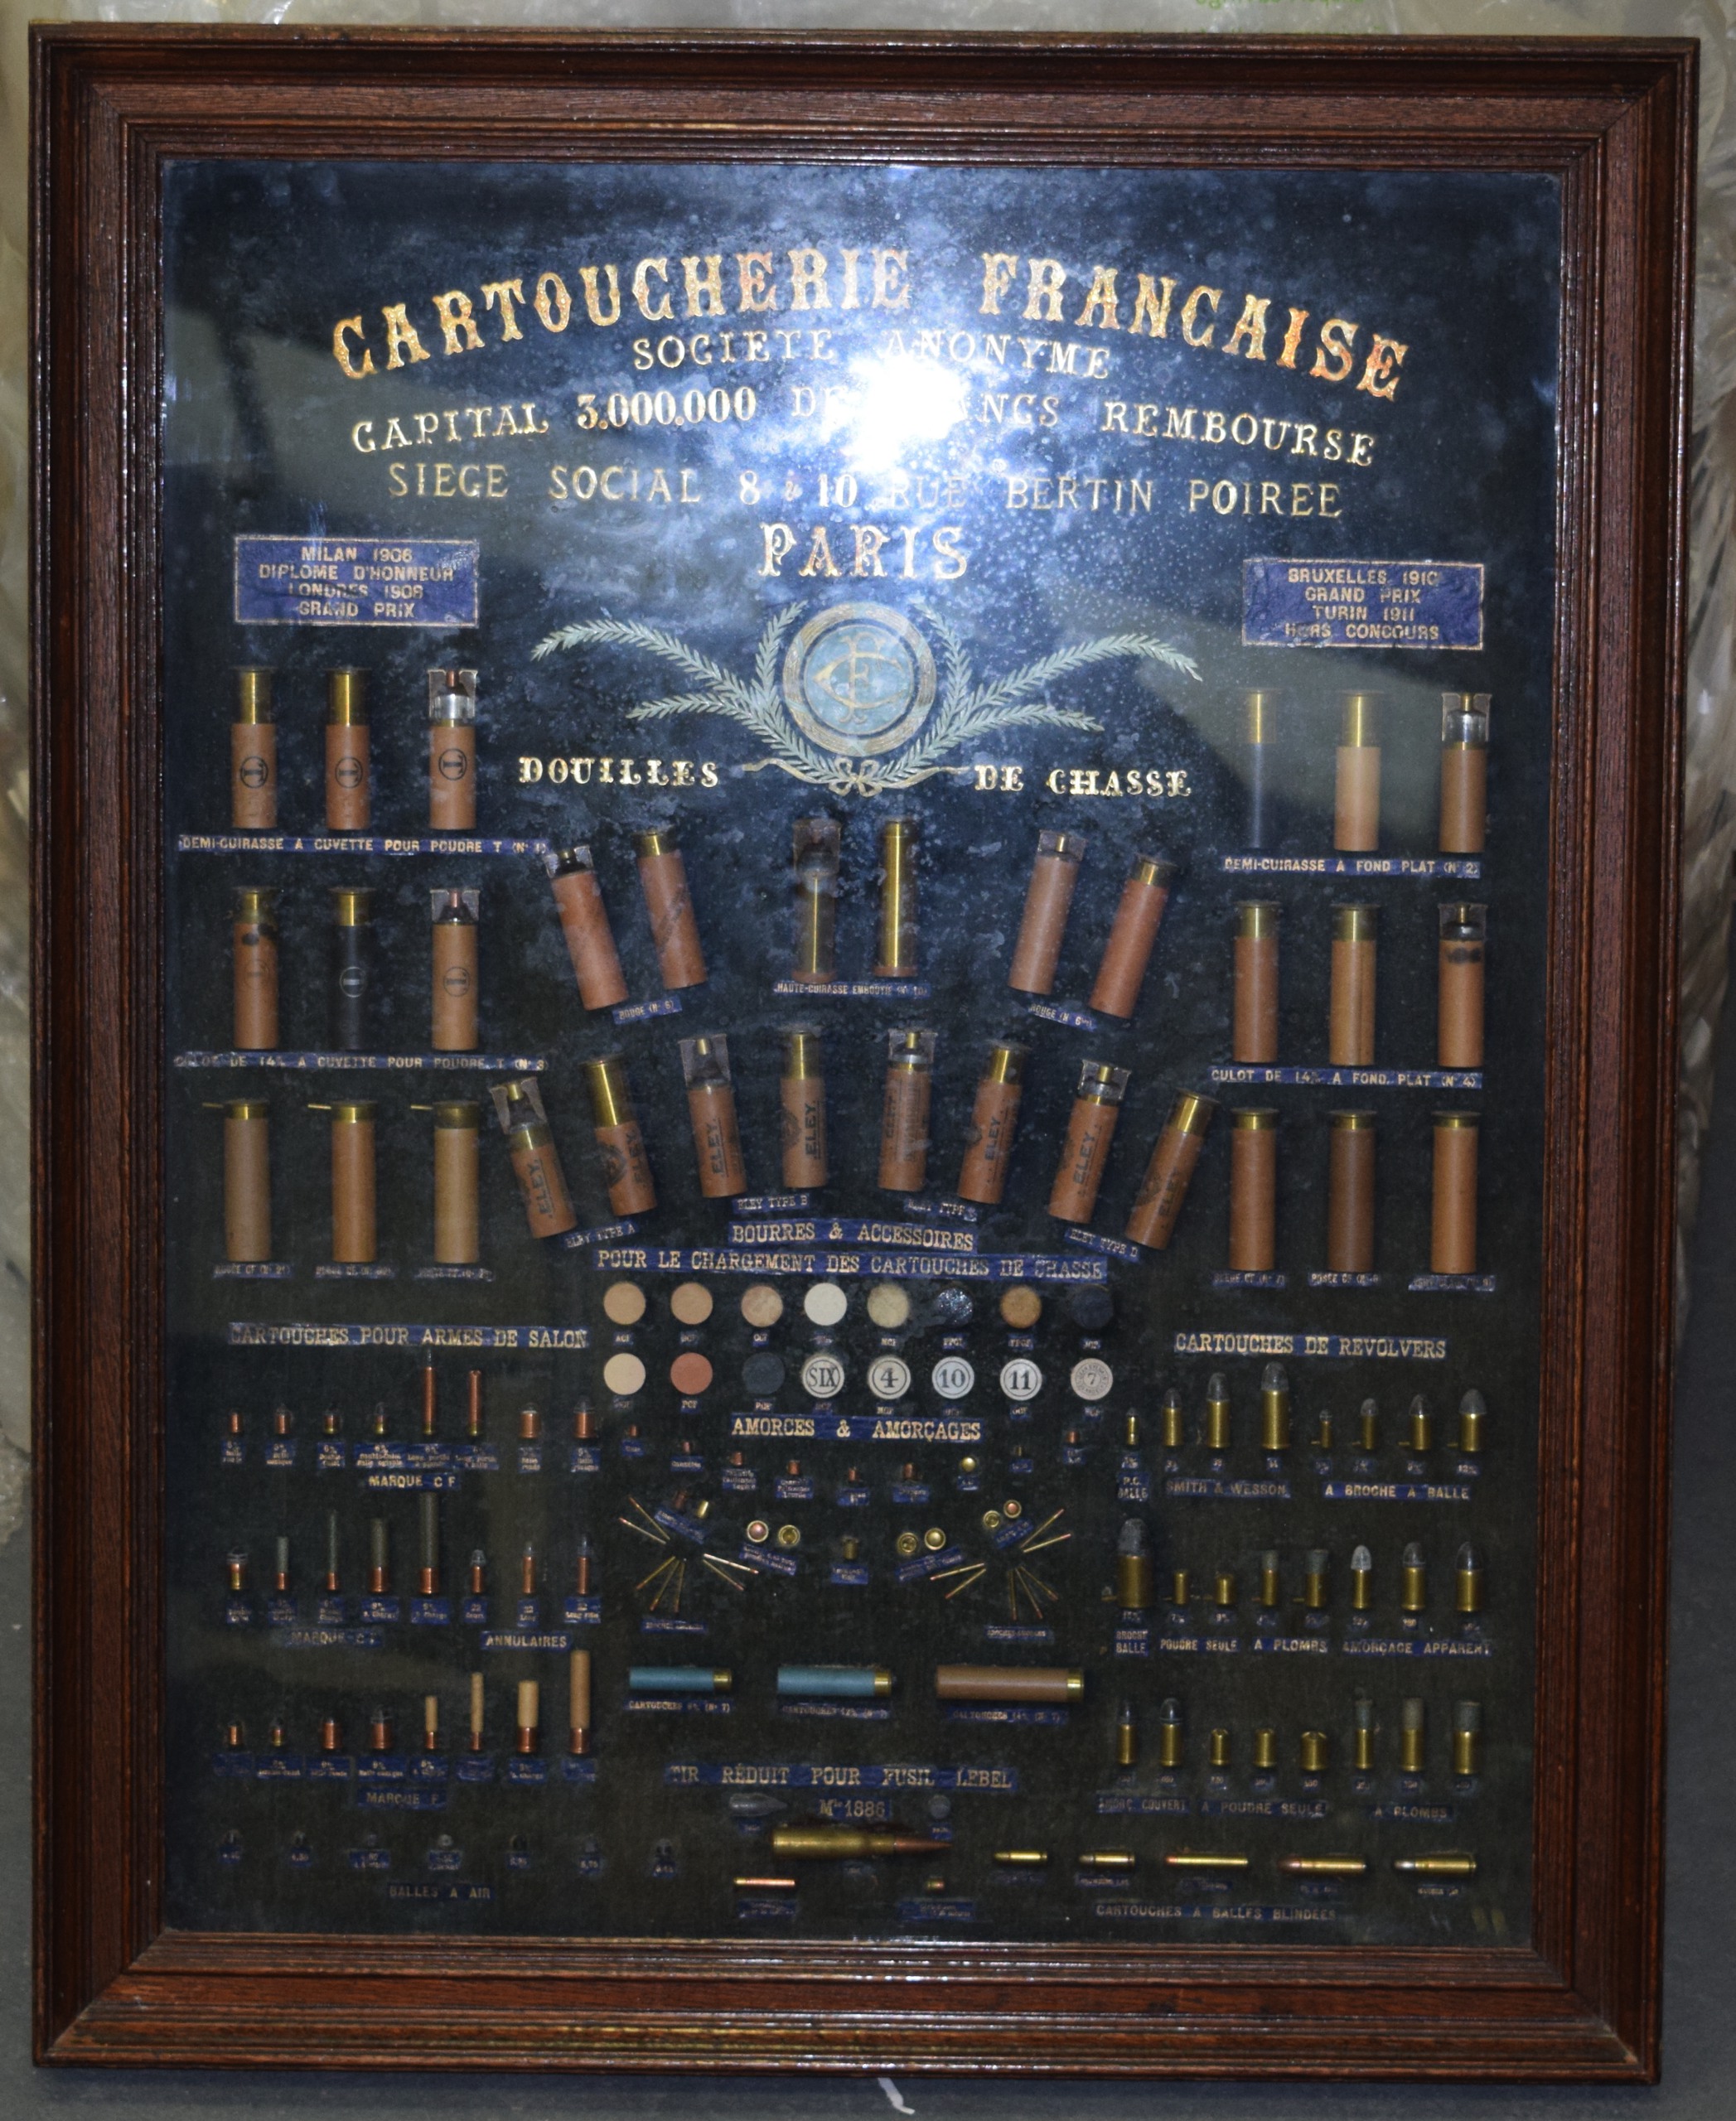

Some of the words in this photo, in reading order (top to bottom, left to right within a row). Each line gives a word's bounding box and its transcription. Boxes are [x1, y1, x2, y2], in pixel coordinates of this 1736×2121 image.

[333, 246, 911, 379] CARTOUCHERIE
[979, 252, 1409, 402] FRANCAISE
[632, 329, 836, 370] SOCIETE
[883, 330, 1111, 379] ANONYME
[351, 402, 549, 453] CAPITAL
[577, 385, 757, 429] 3.000.000
[1102, 401, 1376, 467] REMBOURSE
[388, 462, 510, 499] SIEGE
[550, 465, 701, 503] SOCIAL
[738, 470, 761, 505] 8
[817, 473, 858, 509] 10
[890, 476, 970, 510] RUE
[1005, 477, 1153, 515] BERTIN
[1188, 479, 1342, 519] POIREE
[300, 546, 357, 563] MILAN
[373, 548, 413, 563] 1906
[758, 522, 968, 581] PARIS
[259, 564, 338, 580] DIPLOME
[353, 565, 454, 582] D'HONNEUR
[1288, 568, 1388, 584] BRUXELLES
[1305, 587, 1365, 602] GRAND
[1380, 587, 1421, 604] PRIX
[298, 601, 359, 616] GRAND
[374, 602, 415, 618] PRIX
[1312, 605, 1367, 621] TURIN
[1383, 606, 1415, 621] 1911
[1346, 624, 1440, 640] CONCOURS
[517, 756, 720, 789] DOUILLES
[974, 763, 1024, 793] DE
[1045, 768, 1193, 798] CHASSE
[182, 836, 284, 850] DEMI-CUIRASSE
[294, 838, 303, 850] A
[313, 838, 374, 851] CUVETTE
[384, 839, 420, 852] POUR
[430, 840, 482, 853] POUDRE
[492, 841, 502, 853] T
[1224, 857, 1326, 872] DEMI-CUIRASSE
[1336, 859, 1345, 872] A
[1356, 860, 1391, 872] FOND
[1401, 860, 1435, 873] PLAT
[297, 1057, 307, 1068] A
[317, 1056, 376, 1069] CUVETTE
[387, 1057, 423, 1068] POUR
[1211, 1069, 1255, 1081] CULOT
[1265, 1070, 1282, 1082] DE
[1332, 1072, 1342, 1084] A
[1398, 1074, 1431, 1086] PLAT
[805, 1103, 818, 1155] ELEY
[1073, 1132, 1095, 1184] ELEY
[767, 1196, 796, 1209] TYPE
[732, 1222, 815, 1243] BOURRES
[828, 1222, 843, 1239] &
[857, 1223, 974, 1252] ACCESSOIRES
[597, 1250, 647, 1268] POUR
[658, 1250, 681, 1268] LE
[691, 1251, 815, 1273] CHARGEMENT
[826, 1253, 859, 1273] DES
[871, 1256, 989, 1276] CARTOUCHES
[999, 1259, 1024, 1277] DE
[1034, 1259, 1103, 1280] CHASSE
[230, 1326, 349, 1346] CARTOUCHES
[360, 1326, 409, 1344] POUR
[421, 1327, 483, 1346] ARMES
[494, 1329, 518, 1347] DE
[529, 1329, 588, 1348] SALON
[1175, 1332, 1294, 1355] CARTOUCHES
[1304, 1336, 1329, 1355] DE
[1339, 1336, 1447, 1359] REVOLVERS
[807, 1367, 838, 1387] SIX
[880, 1367, 898, 1387] 4
[938, 1368, 965, 1382] 10
[1009, 1370, 1032, 1390] 11
[1087, 1373, 1095, 1385] 7
[731, 1418, 815, 1437] AMORCES
[836, 1419, 851, 1438] &
[872, 1419, 981, 1442] AMORÇAGES
[368, 1474, 423, 1488] MARQUE
[433, 1476, 442, 1488] C
[447, 1476, 456, 1487] F
[1324, 1484, 1333, 1496] A
[1344, 1485, 1396, 1497] BROCHE
[1406, 1486, 1415, 1498] A
[1427, 1486, 1469, 1500] BALLE
[486, 1635, 568, 1649] ANNULAIRES
[1115, 1642, 1147, 1654] BALLE
[1160, 1639, 1198, 1650] POUDRE
[1254, 1639, 1262, 1650] A
[1424, 1642, 1490, 1655] APPARENT
[670, 1766, 699, 1784] TIR
[722, 1764, 790, 1785] RÉDUIT
[810, 1766, 861, 1785] POUR
[883, 1767, 935, 1787] FUSIL
[844, 1800, 885, 1818] 1886
[1141, 1799, 1187, 1811] COUVERT
[1221, 1801, 1272, 1814] POUDRE
[1095, 1905, 1182, 1919] CARTOUCHES
